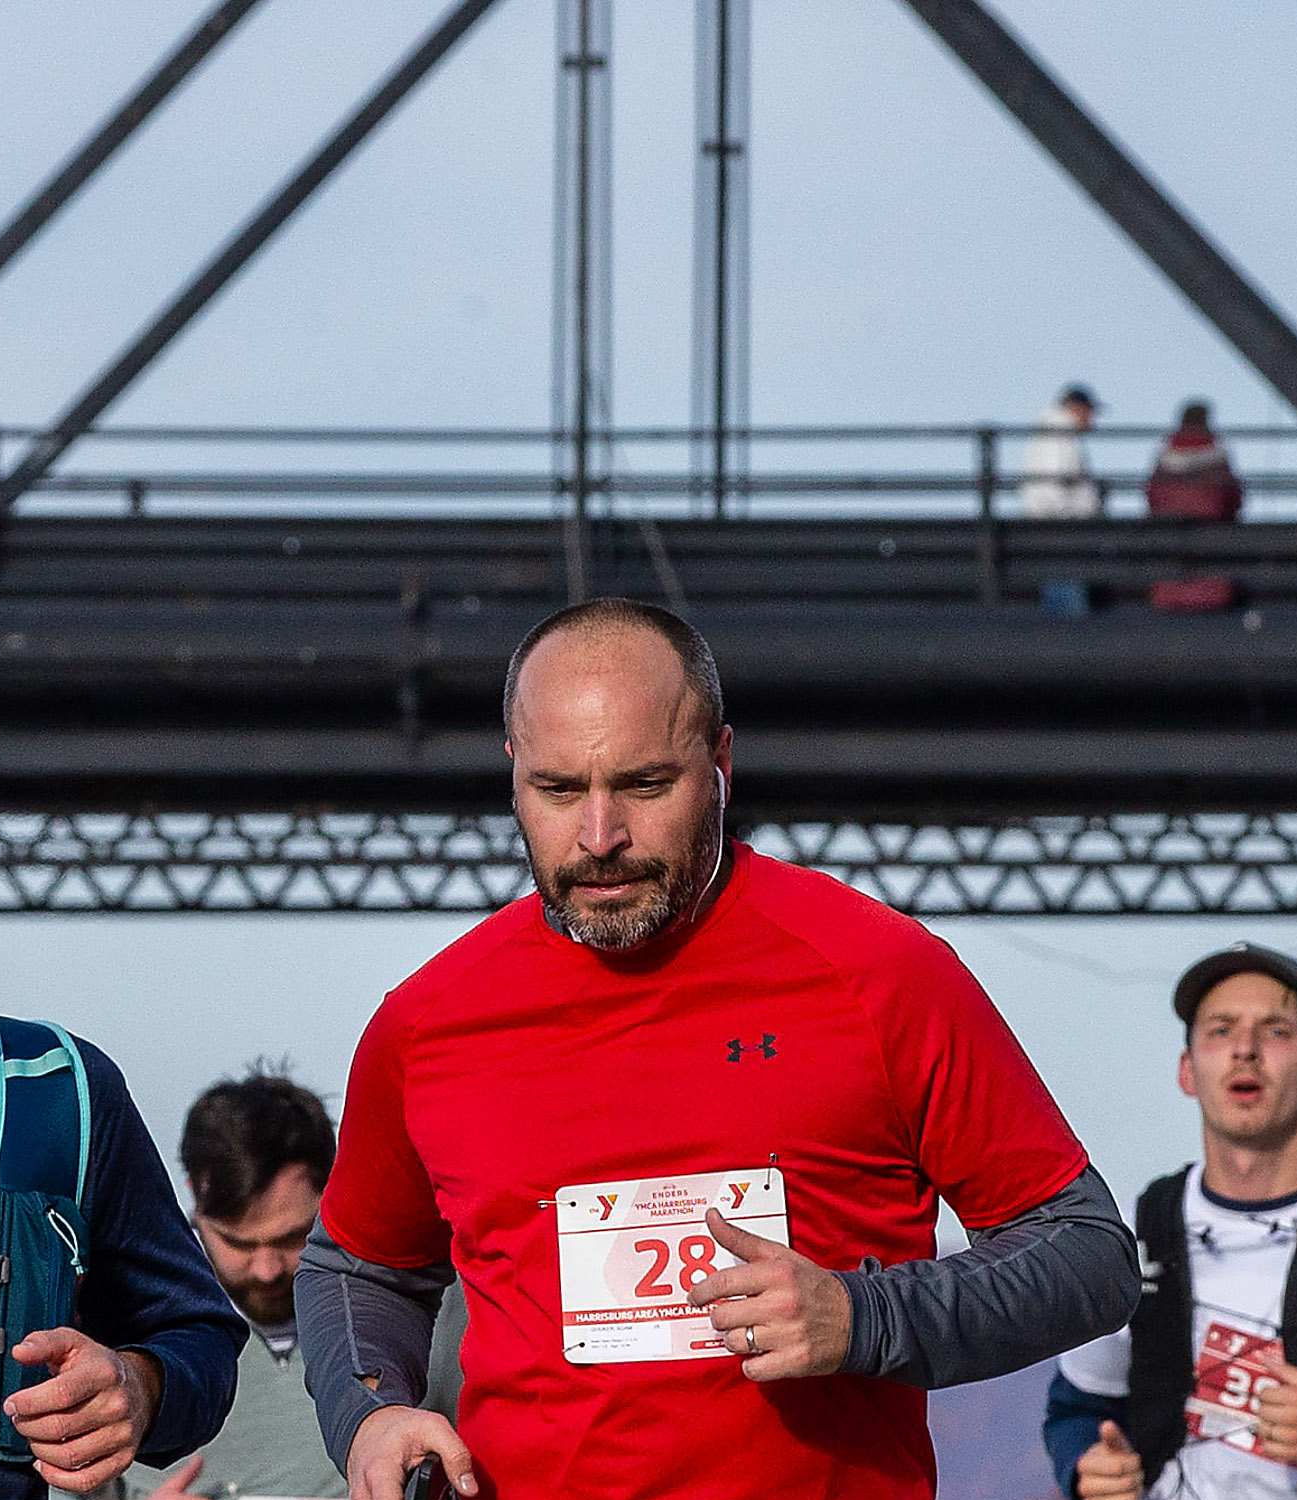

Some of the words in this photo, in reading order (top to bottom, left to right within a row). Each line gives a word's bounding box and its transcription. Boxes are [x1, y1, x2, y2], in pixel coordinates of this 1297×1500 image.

[652, 1190, 688, 1199] ENDERS
[635, 1202, 657, 1211] YMCA
[658, 1198, 708, 1208] HARRISBURG
[650, 1208, 694, 1218] MARATHON
[634, 1235, 718, 1298] 28
[576, 1311, 633, 1322] HARRISBURG
[634, 1309, 658, 1319] AREA
[657, 1307, 684, 1317] YMCA
[1218, 1366, 1280, 1413] 3
